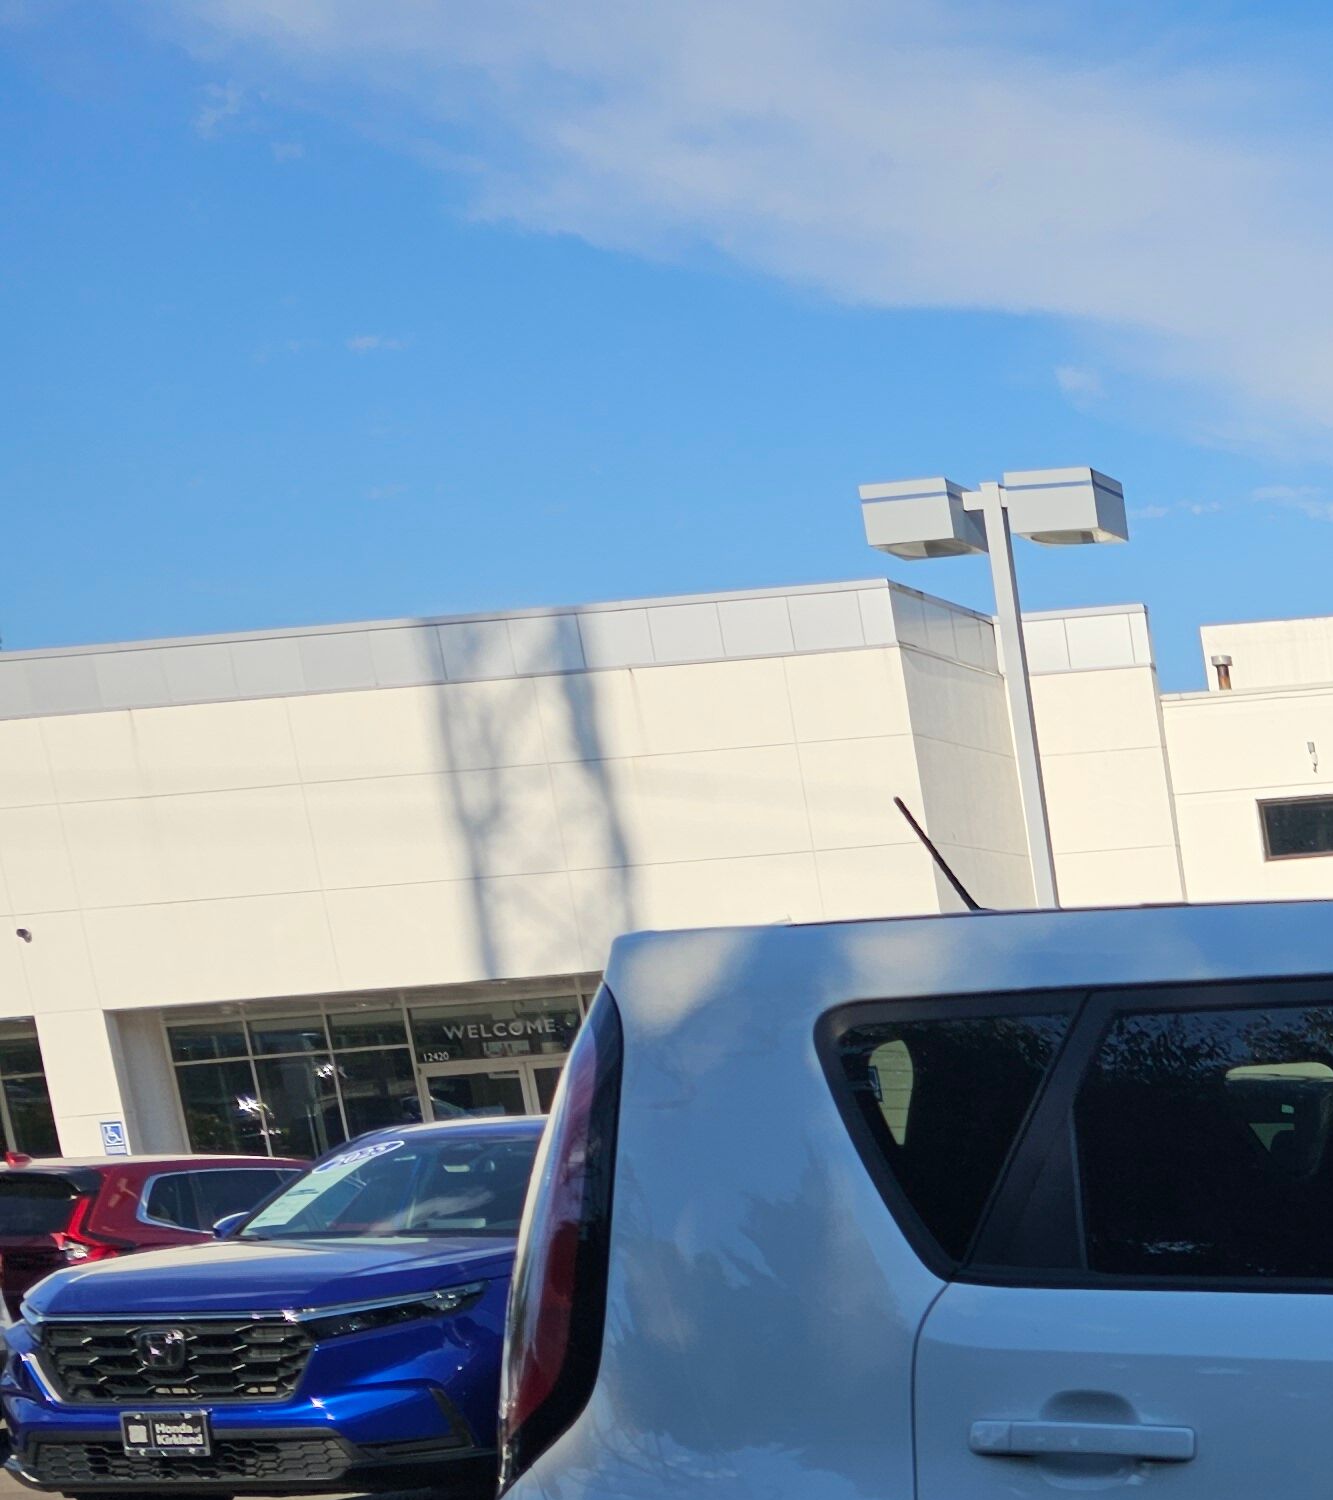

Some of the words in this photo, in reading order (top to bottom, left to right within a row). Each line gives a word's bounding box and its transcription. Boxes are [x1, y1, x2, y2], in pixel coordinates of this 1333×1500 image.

[443, 1019, 557, 1039] WELCOME
[423, 1051, 450, 1062] 12420
[155, 1422, 193, 1434] Honda
[156, 1433, 204, 1445] Kirkland
